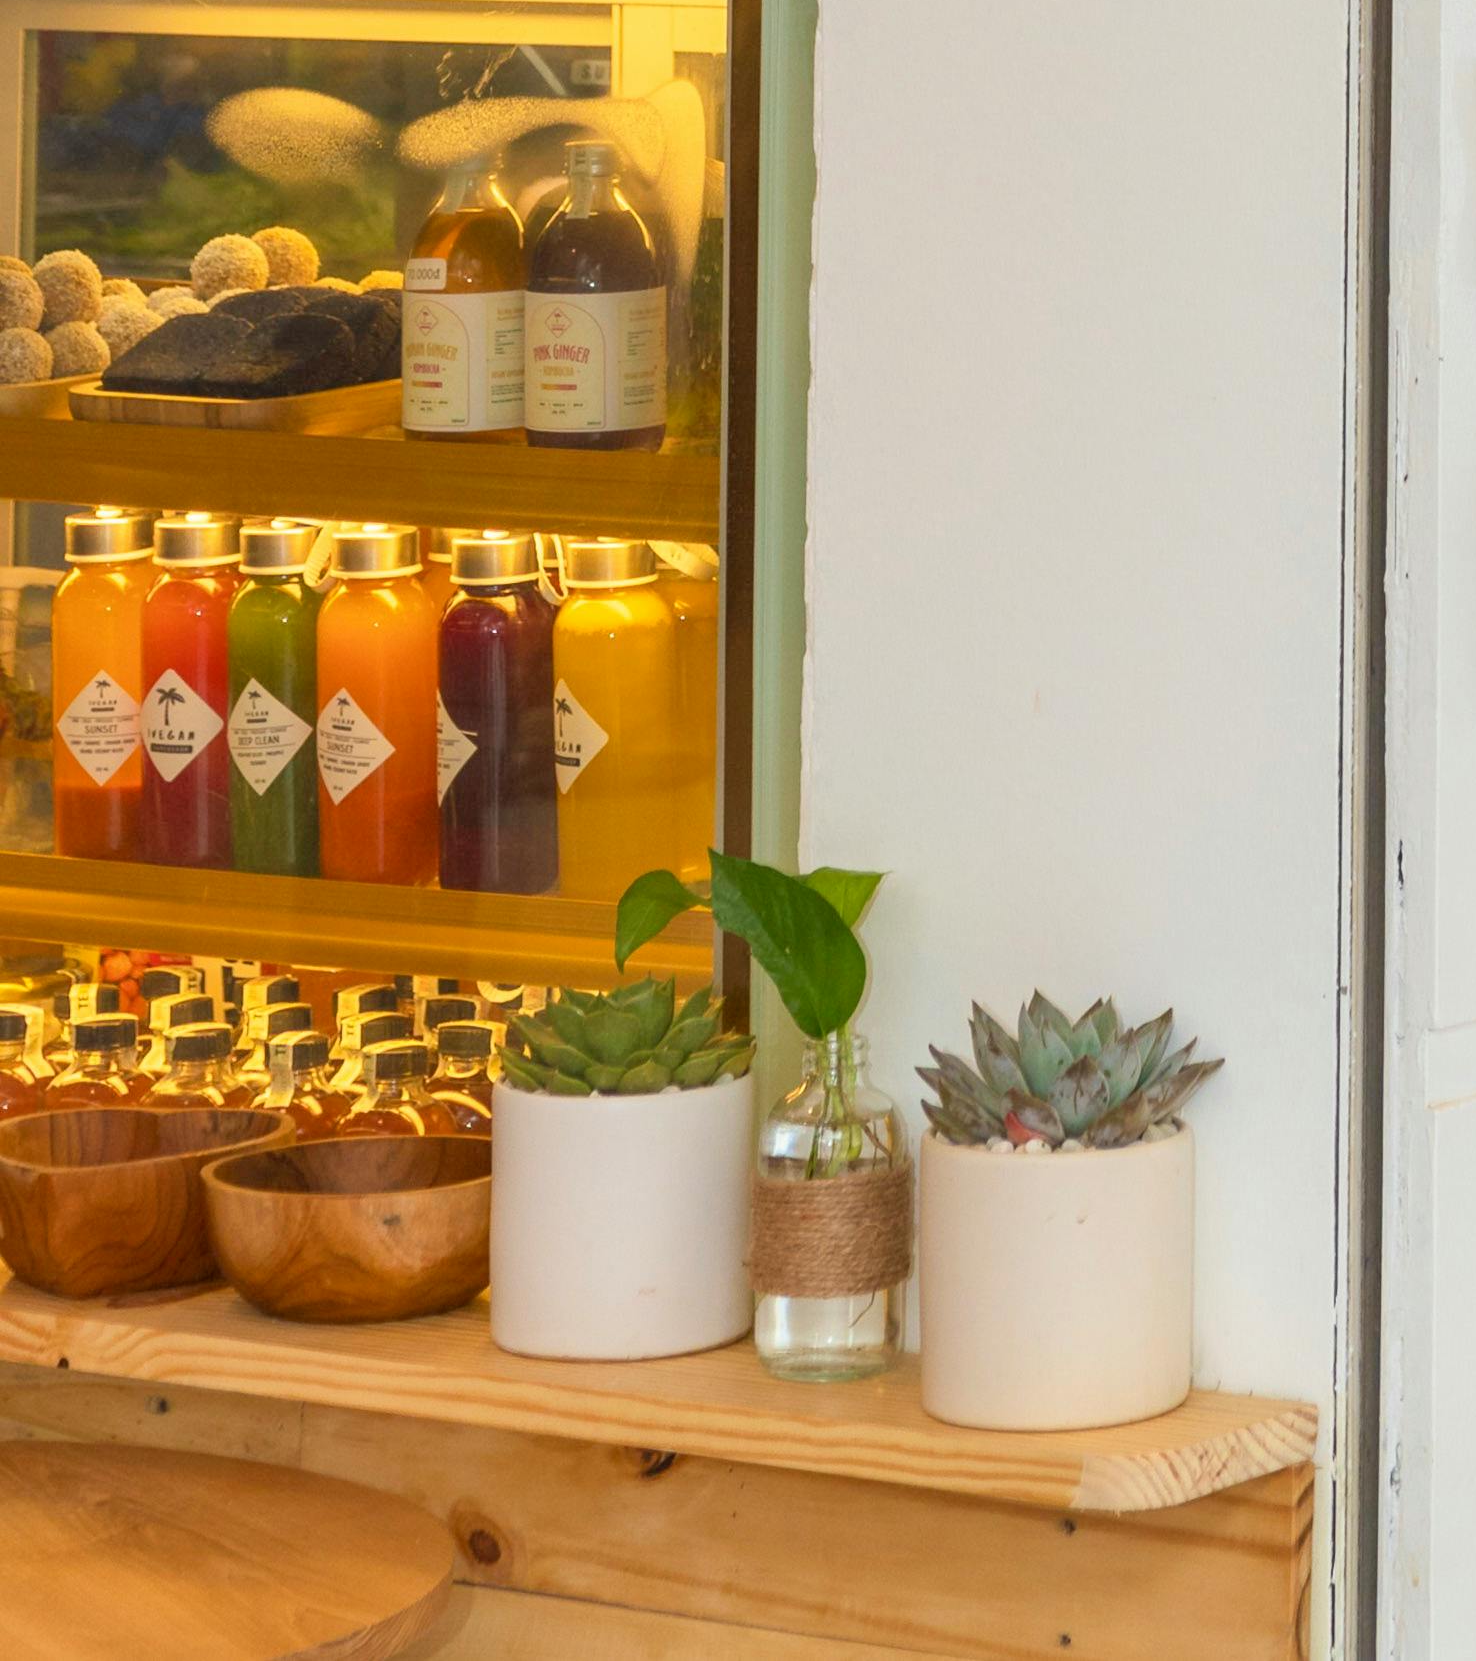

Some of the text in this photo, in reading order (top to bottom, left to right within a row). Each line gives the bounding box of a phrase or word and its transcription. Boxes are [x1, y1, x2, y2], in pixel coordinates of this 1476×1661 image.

[553, 343, 591, 365] GINGER
[84, 724, 118, 735] SUNSET
[254, 735, 280, 746] CLEAN
[327, 741, 354, 754] SUNSET
